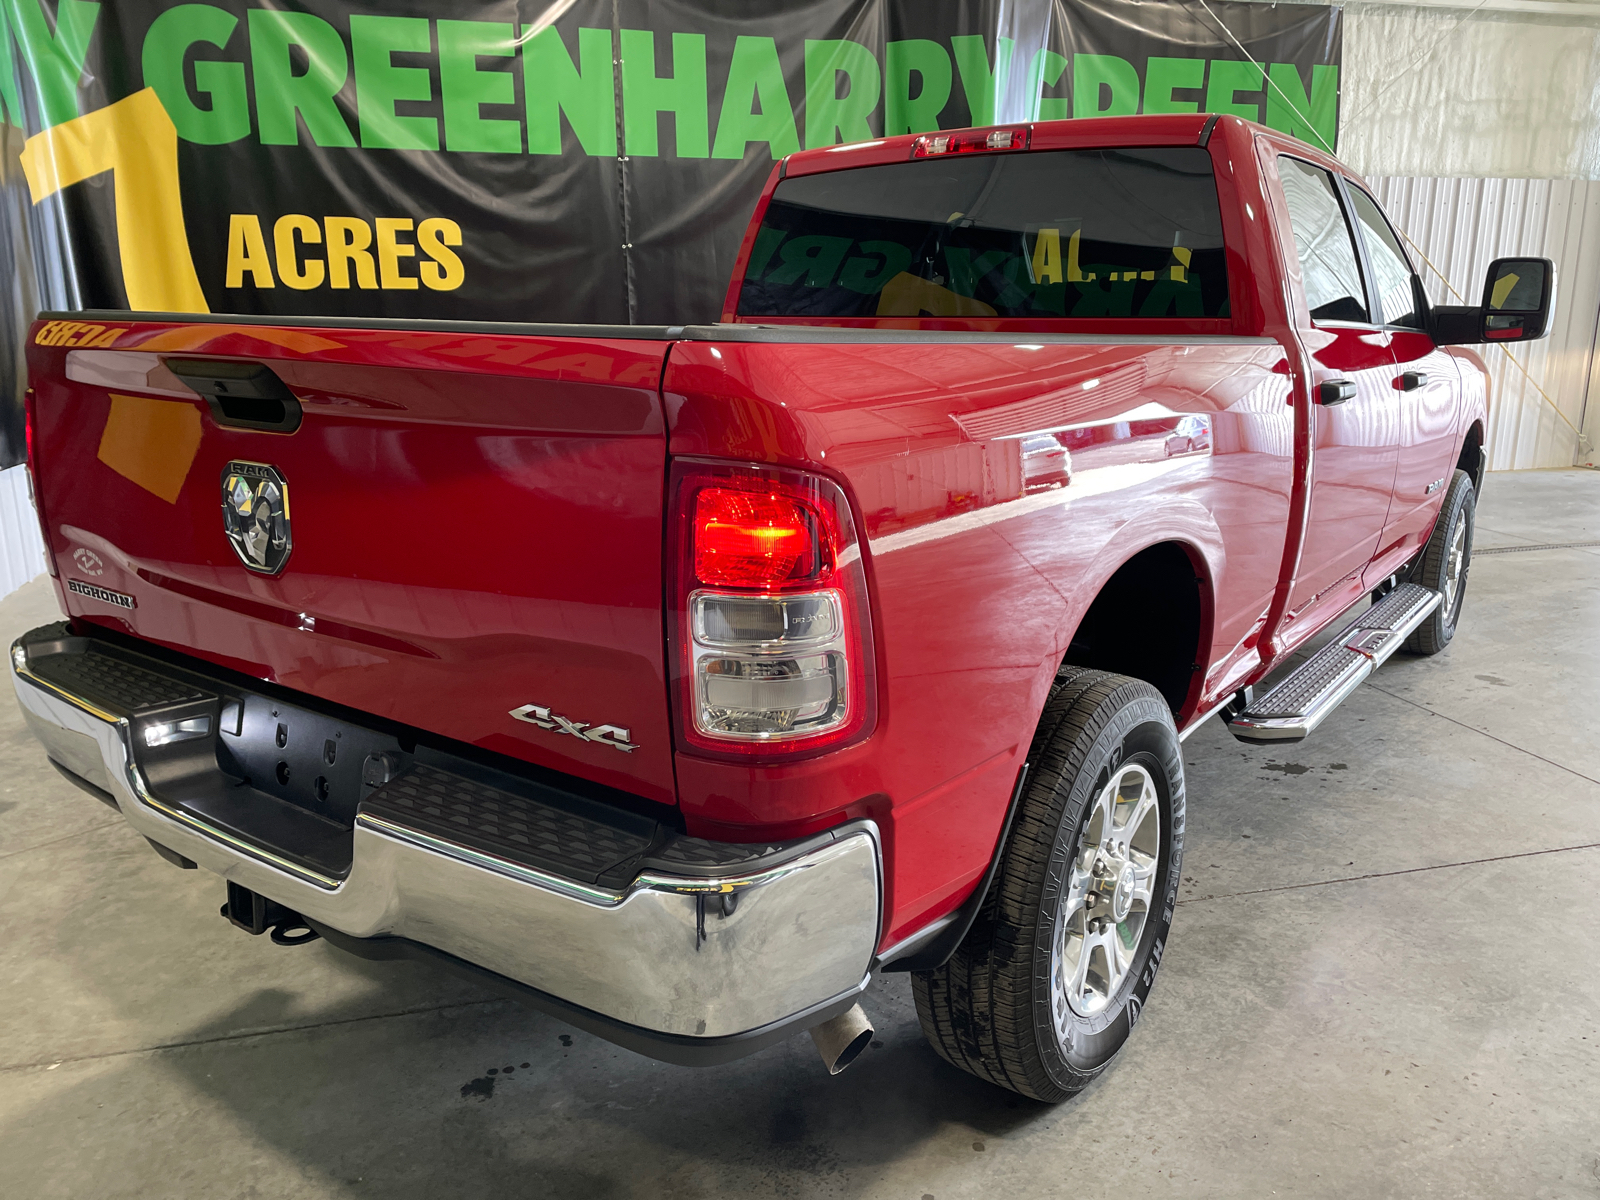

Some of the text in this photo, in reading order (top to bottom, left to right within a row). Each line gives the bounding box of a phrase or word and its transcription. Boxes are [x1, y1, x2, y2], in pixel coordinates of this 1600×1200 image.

[142, 4, 619, 157] GREEN
[225, 213, 465, 291] ACRES
[230, 463, 269, 478] RAM
[67, 579, 135, 610] BIGHORN
[1162, 747, 1186, 926] TRANSFORCE
